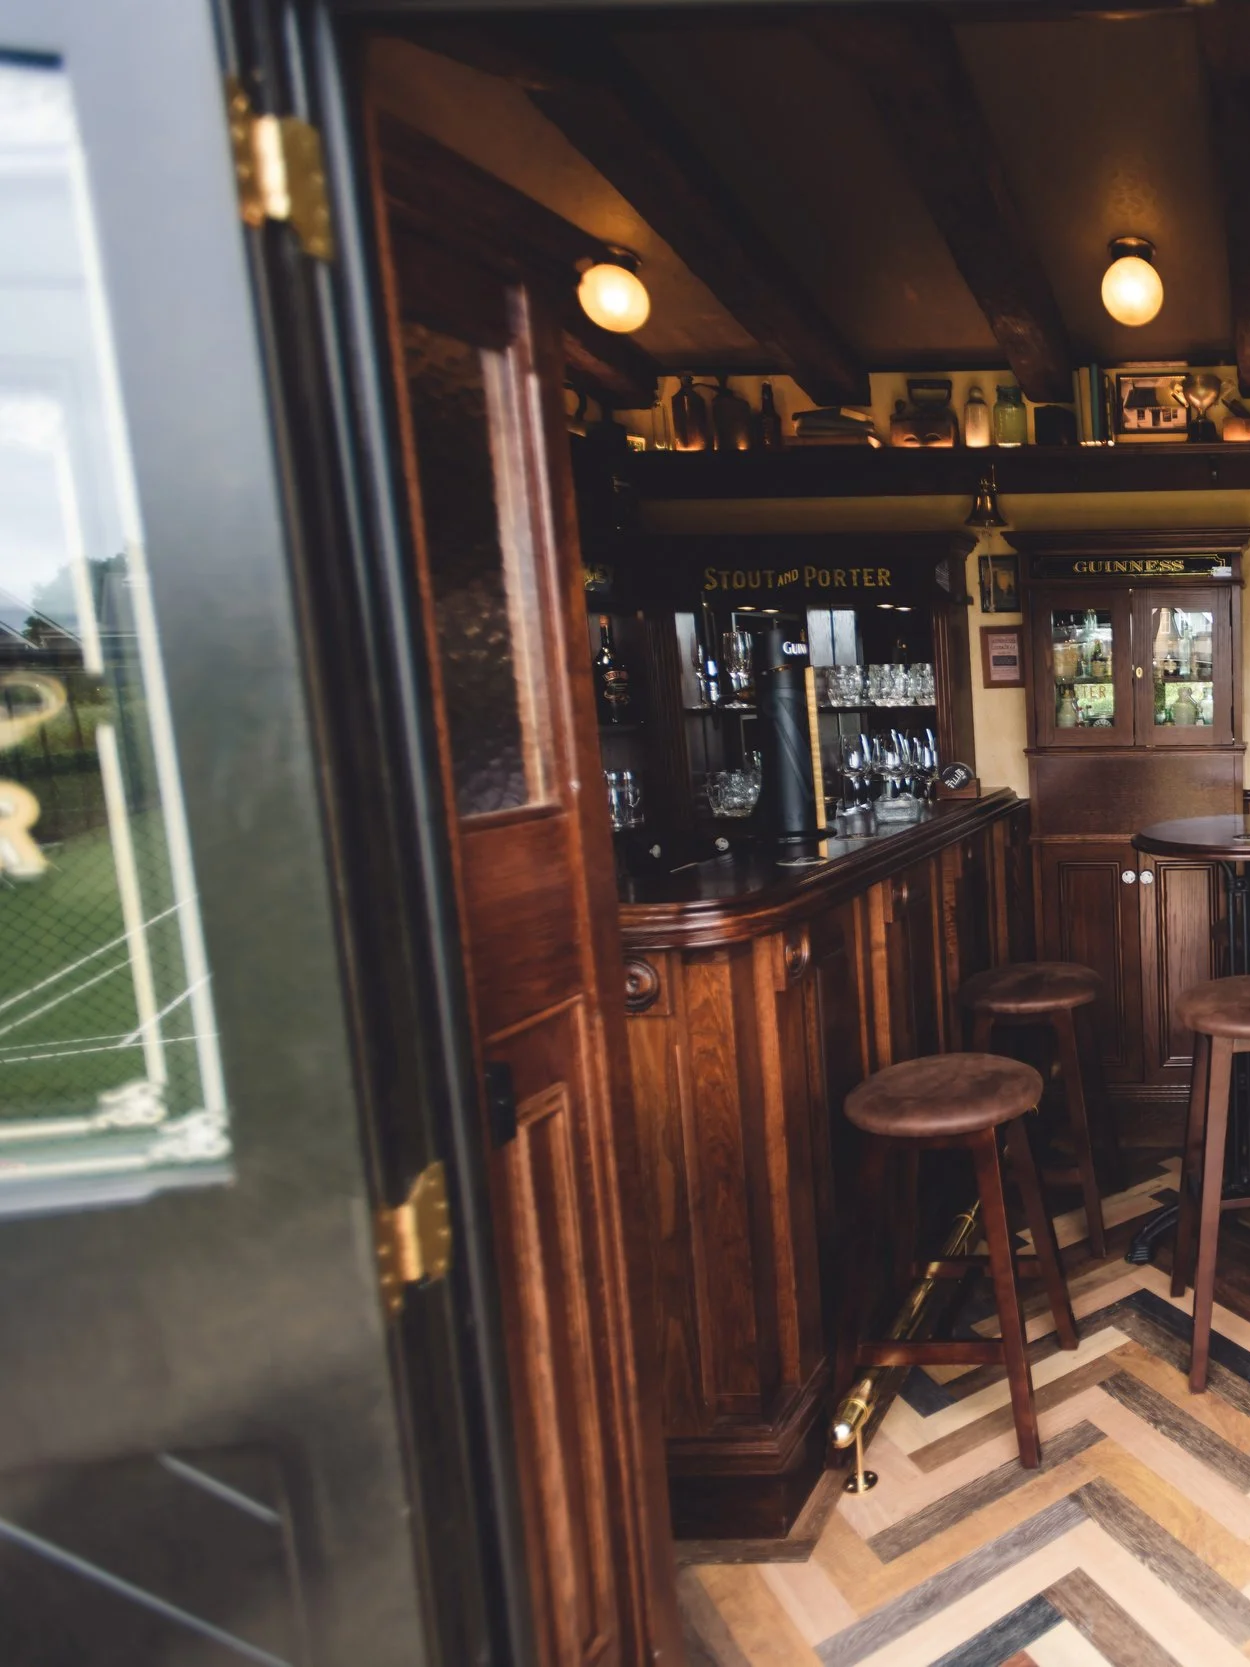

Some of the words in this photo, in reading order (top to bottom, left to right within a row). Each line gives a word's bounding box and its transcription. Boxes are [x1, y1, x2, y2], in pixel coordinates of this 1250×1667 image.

[1073, 559, 1185, 573] GUINNESS
[703, 565, 776, 591] STOUT
[777, 569, 799, 587] AND
[804, 565, 892, 588] PORTER
